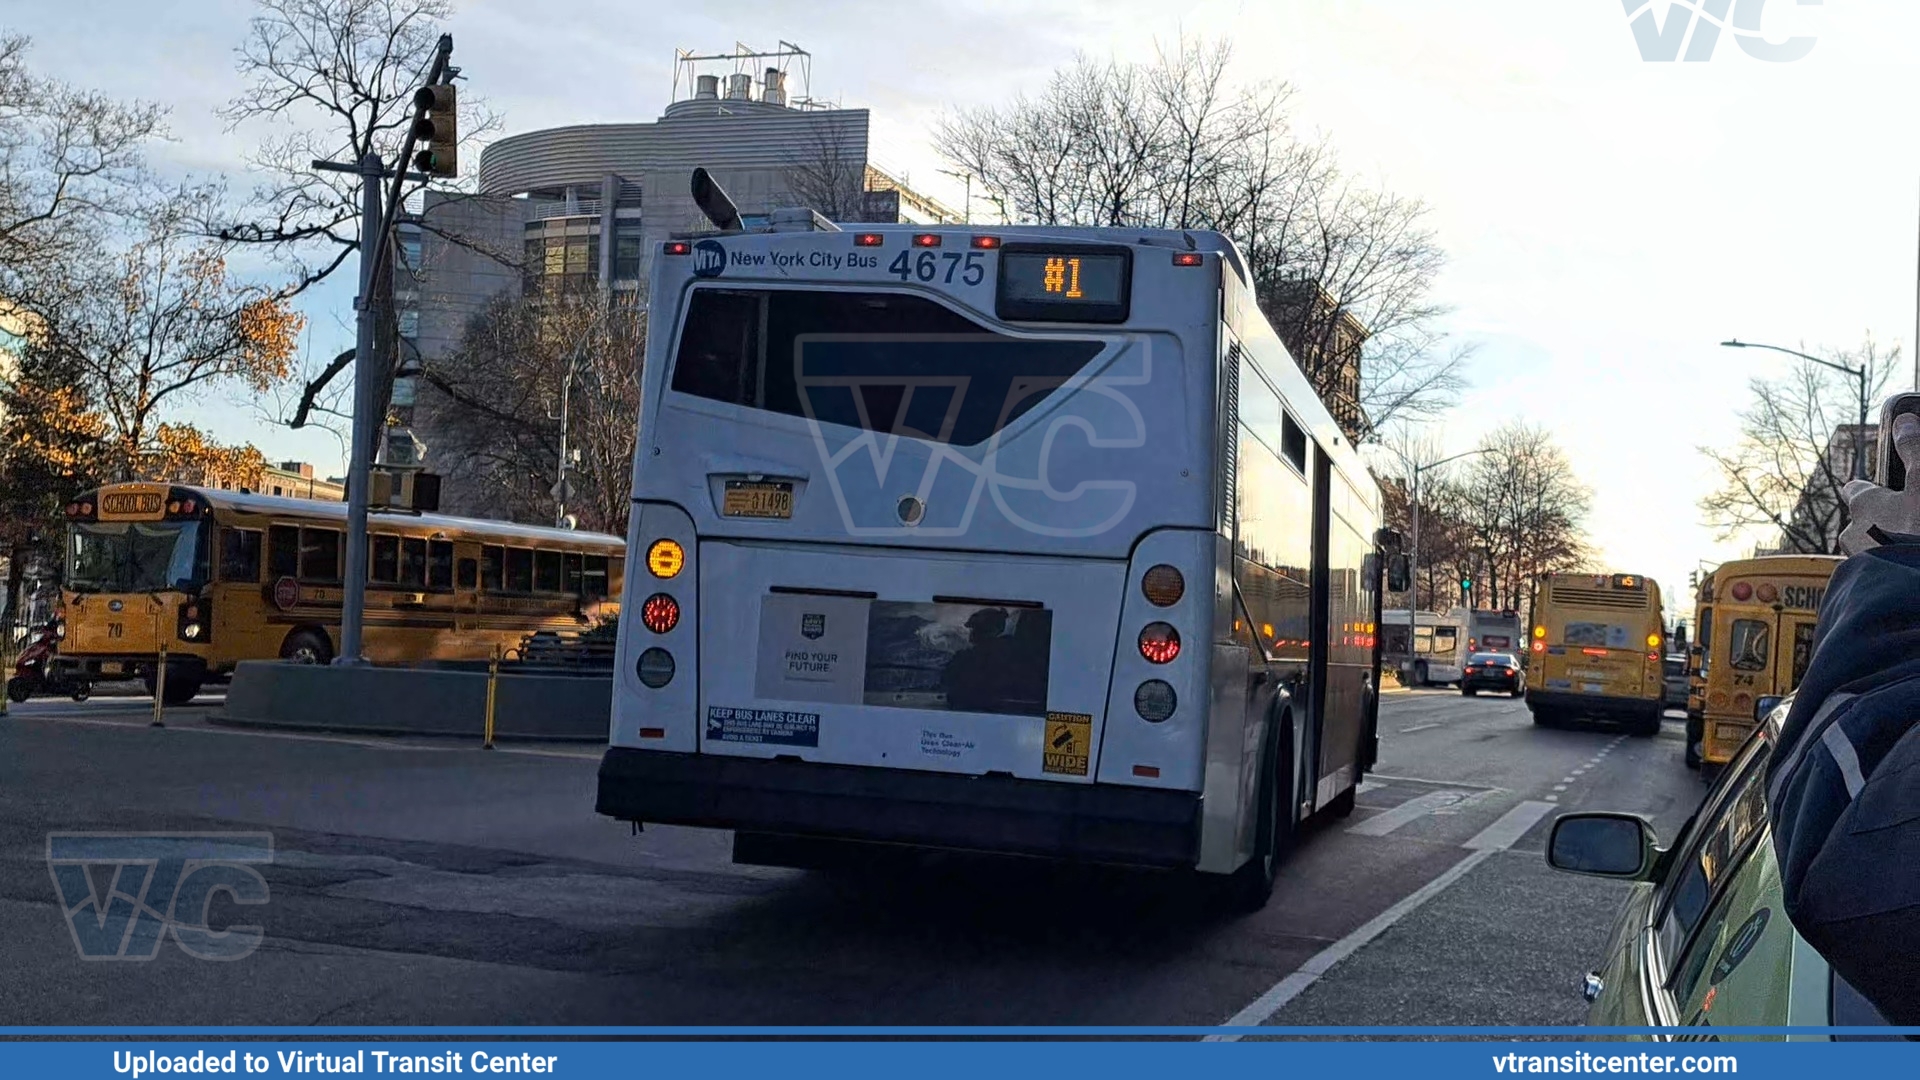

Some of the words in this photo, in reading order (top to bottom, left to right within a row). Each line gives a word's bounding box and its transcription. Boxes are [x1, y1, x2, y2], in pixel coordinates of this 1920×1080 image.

[693, 247, 722, 273] MTA
[731, 251, 766, 266] New
[770, 251, 805, 267] York
[809, 252, 842, 270] City
[847, 253, 878, 268] Bus
[888, 250, 985, 286] 4675
[1044, 258, 1082, 298] #1
[103, 494, 139, 513] SCHOOL
[107, 622, 123, 638] 70
[784, 652, 809, 660] FIND
[810, 653, 838, 663] YOUR
[1734, 674, 1754, 686] 74
[710, 708, 733, 718] KEEP
[735, 711, 753, 720] BUS
[755, 712, 784, 722] LANES
[786, 714, 816, 725] CLEAR
[1045, 755, 1087, 769] WIDE
